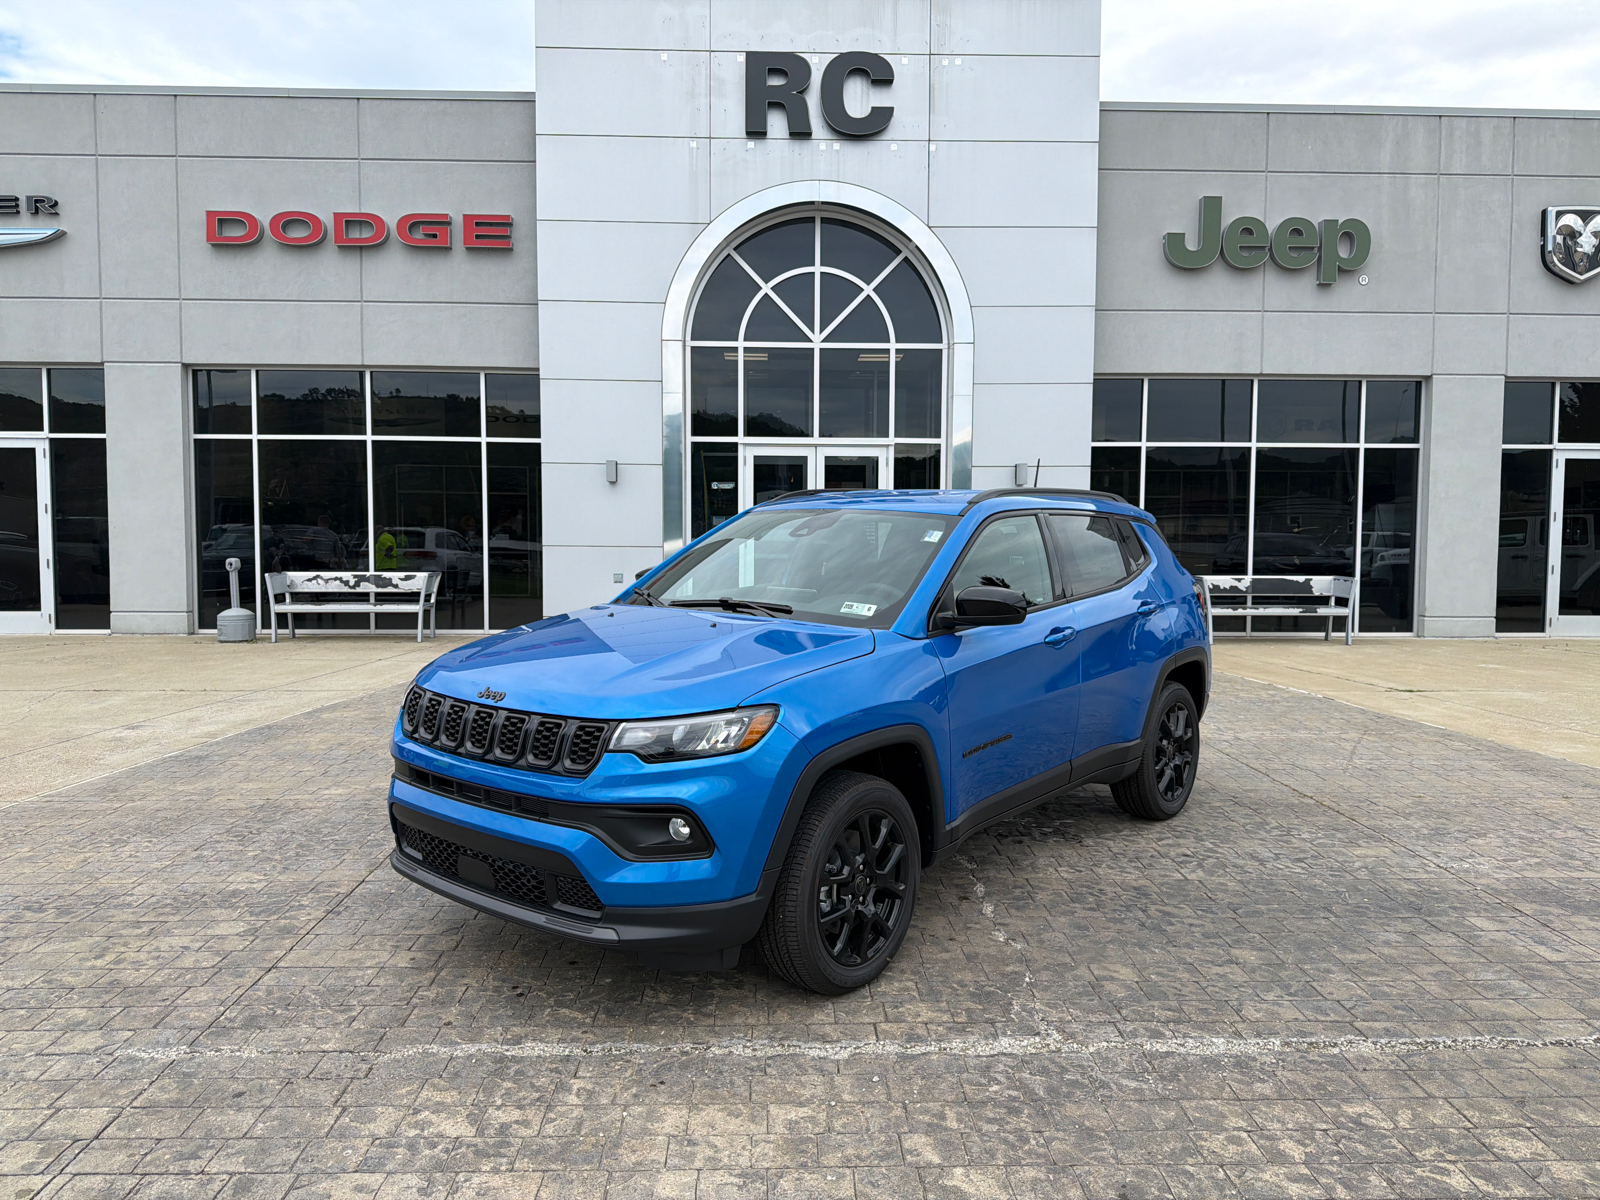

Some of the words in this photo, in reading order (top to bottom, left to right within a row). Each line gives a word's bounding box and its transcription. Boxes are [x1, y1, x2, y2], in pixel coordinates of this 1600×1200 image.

[745, 51, 895, 138] RC
[205, 210, 513, 249] DODGE
[1163, 196, 1371, 285] Jeep
[477, 686, 506, 703] Jeep
